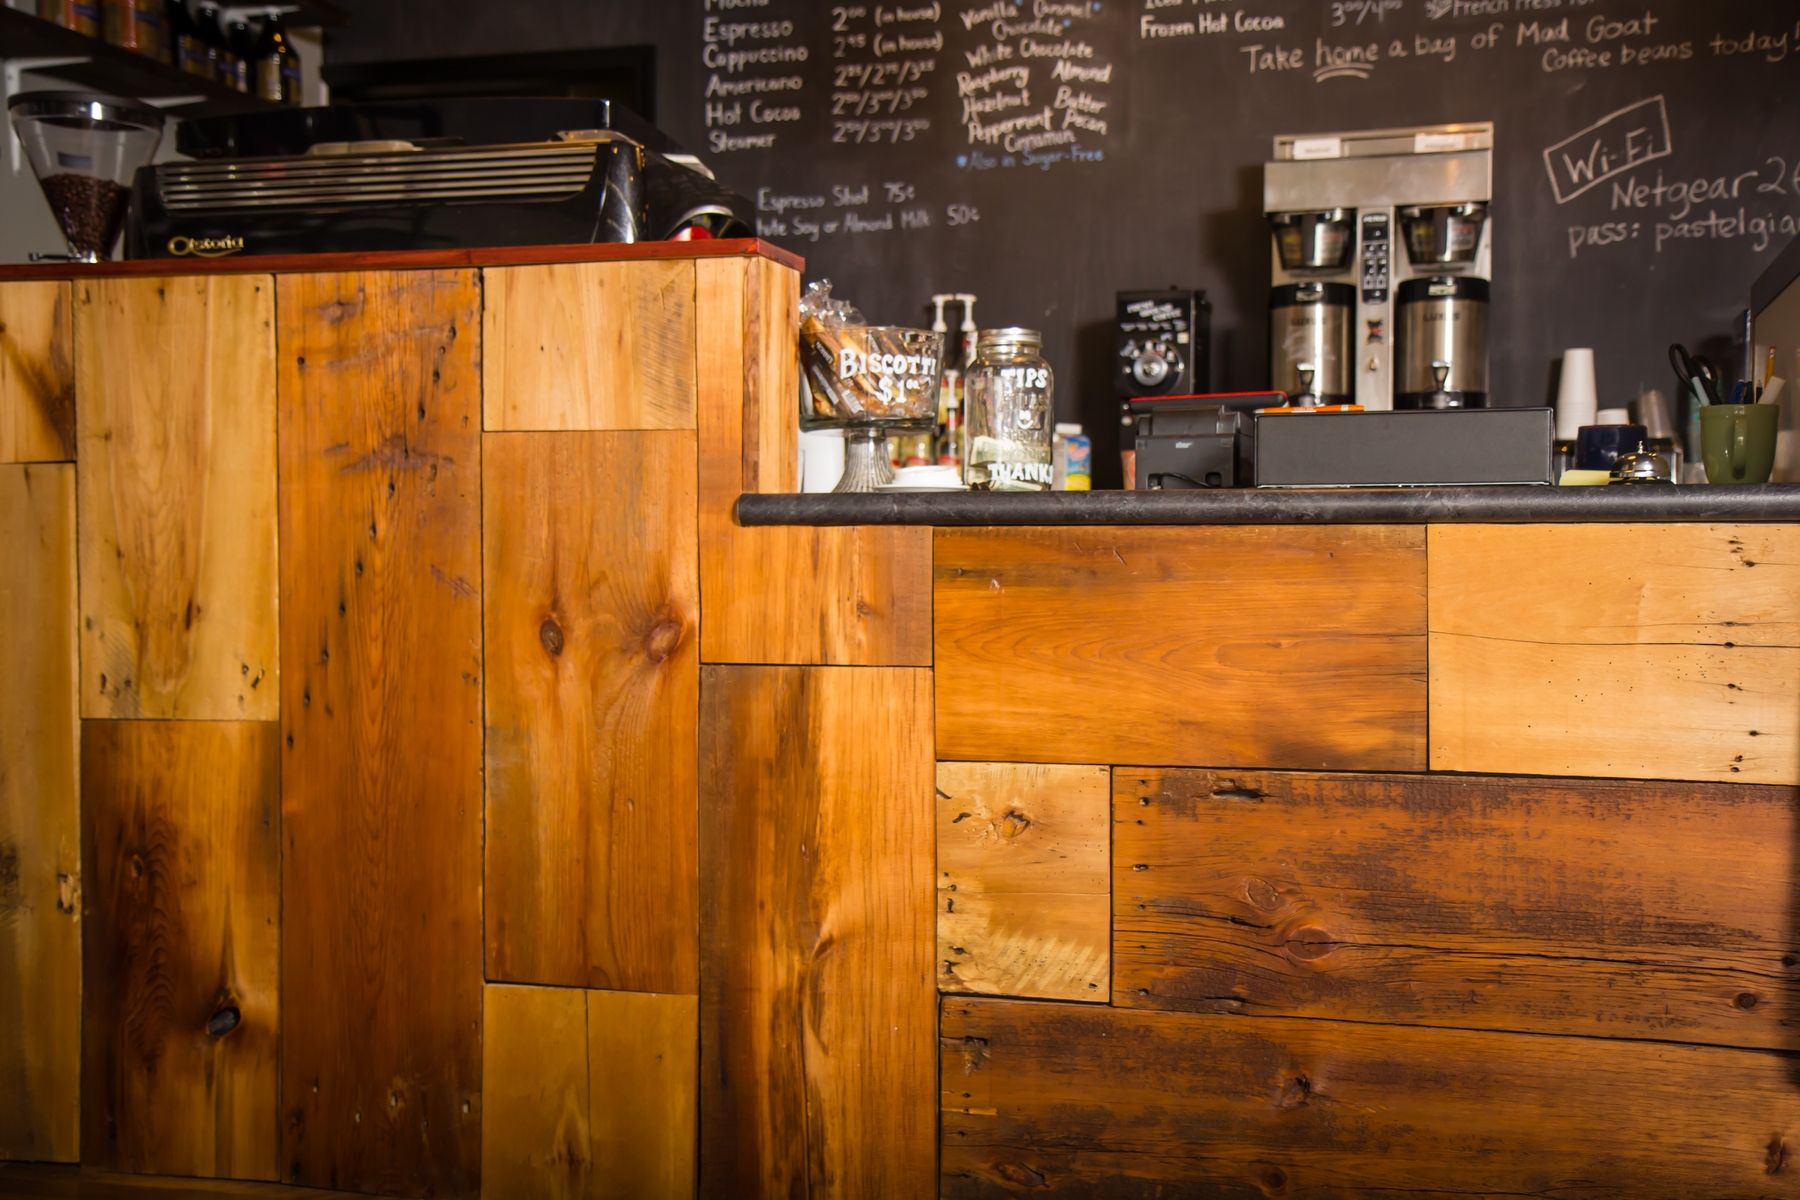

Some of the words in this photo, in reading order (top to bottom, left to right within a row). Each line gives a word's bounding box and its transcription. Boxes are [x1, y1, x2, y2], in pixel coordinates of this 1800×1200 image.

[703, 16, 793, 47] Espresso
[1140, 14, 1195, 39] Frozen
[1199, 12, 1228, 34] Hot
[1234, 9, 1285, 32] Cocoa
[1240, 45, 1304, 73] Take
[1315, 37, 1378, 66] home
[1388, 41, 1408, 58] a
[1415, 35, 1456, 62] bag
[1471, 23, 1504, 49] of
[1516, 18, 1571, 46] Mad
[1586, 10, 1659, 43] Goat
[1541, 48, 1611, 73] Coffee
[1620, 40, 1694, 67] beans
[702, 43, 809, 73] Cappuccino
[1051, 59, 1112, 84] Almond
[705, 72, 803, 98] Americano
[706, 101, 741, 127] Hot
[750, 99, 801, 124] Cocoa
[709, 129, 776, 153] Steamer
[1563, 127, 1656, 184] Wi-Fi
[757, 187, 825, 214] Espresso
[832, 184, 869, 207] Shot
[843, 213, 893, 233] Almond
[1568, 221, 1641, 259] pass:
[1655, 206, 1800, 252] pastelgia
[839, 349, 936, 380] BISCOTTI
[1001, 368, 1048, 391] TIPS
